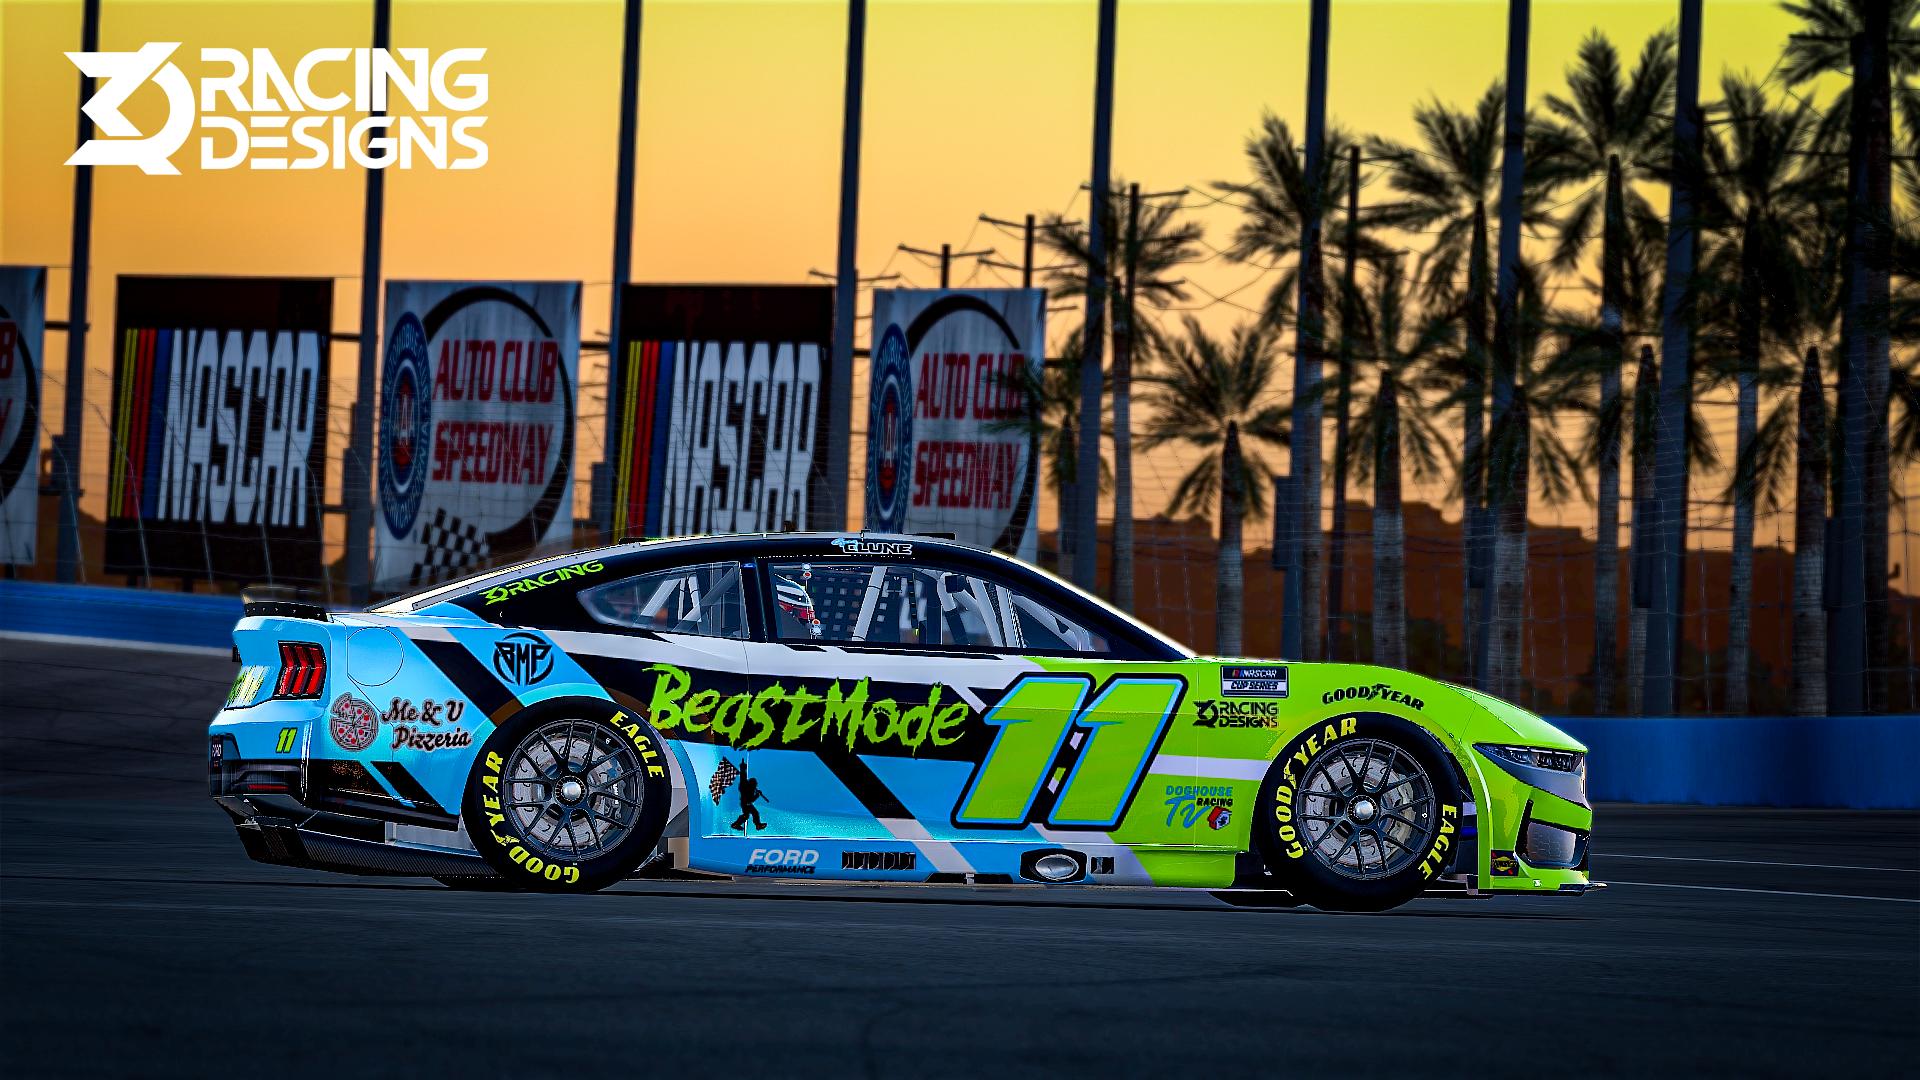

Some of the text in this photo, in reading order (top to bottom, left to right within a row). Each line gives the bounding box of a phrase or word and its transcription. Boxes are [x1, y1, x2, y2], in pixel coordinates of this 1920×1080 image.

[432, 339, 558, 403] AUTO CLUB
[914, 353, 971, 420] AUTO
[157, 329, 320, 527] NASCAR
[661, 342, 820, 537] NASCAR
[431, 420, 552, 485] SPEEDWAY
[913, 441, 1020, 510] SPEEDWAY
[843, 542, 913, 555] CLUNE
[506, 560, 604, 596] RACING
[381, 697, 419, 723] Me
[421, 698, 444, 726] &
[1219, 702, 1278, 715] RACING
[1322, 683, 1425, 711] GOODYEAR
[391, 725, 473, 751] Pizzeria
[1219, 716, 1278, 728] DESIGNS
[276, 728, 297, 753] 11
[610, 711, 664, 777] EAGLE
[950, 672, 1188, 831] 11
[1166, 785, 1233, 796] DOGHOUSE
[1196, 797, 1233, 807] RACING
[1276, 717, 1357, 858] GOODYEAR
[483, 751, 580, 883] GOODYEAR
[1165, 794, 1211, 828] TV
[749, 849, 820, 865] FORD
[1418, 804, 1457, 880] EAGLE
[745, 864, 816, 874] PERFORMANCE
